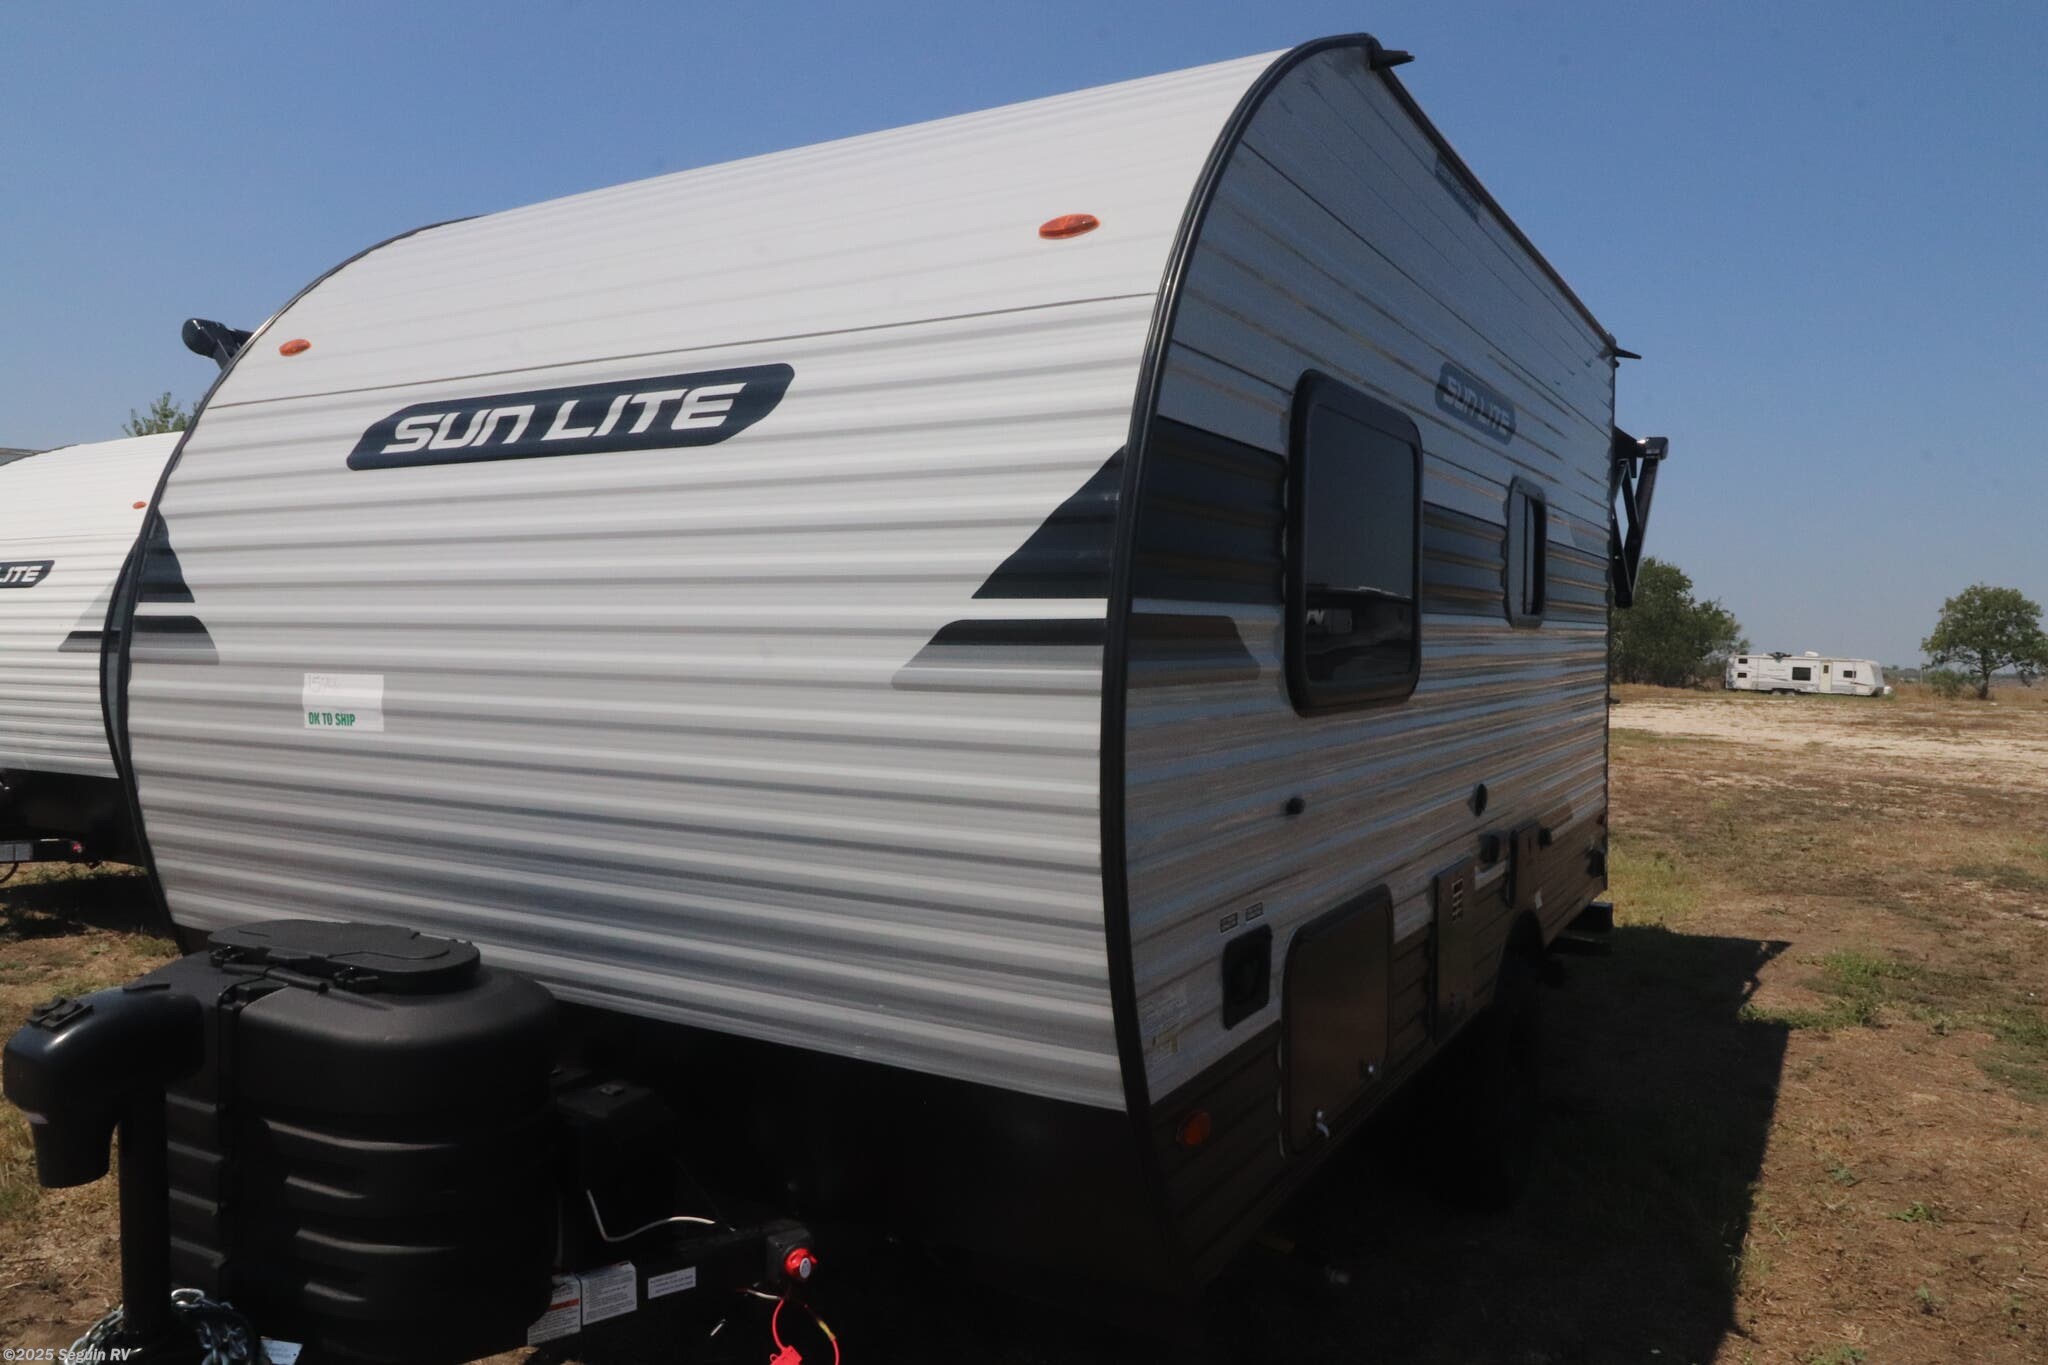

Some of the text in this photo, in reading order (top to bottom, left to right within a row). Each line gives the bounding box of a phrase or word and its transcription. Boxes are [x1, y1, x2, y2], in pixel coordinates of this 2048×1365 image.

[541, 382, 748, 441] LITE
[308, 711, 356, 727] OK TO SHIP
